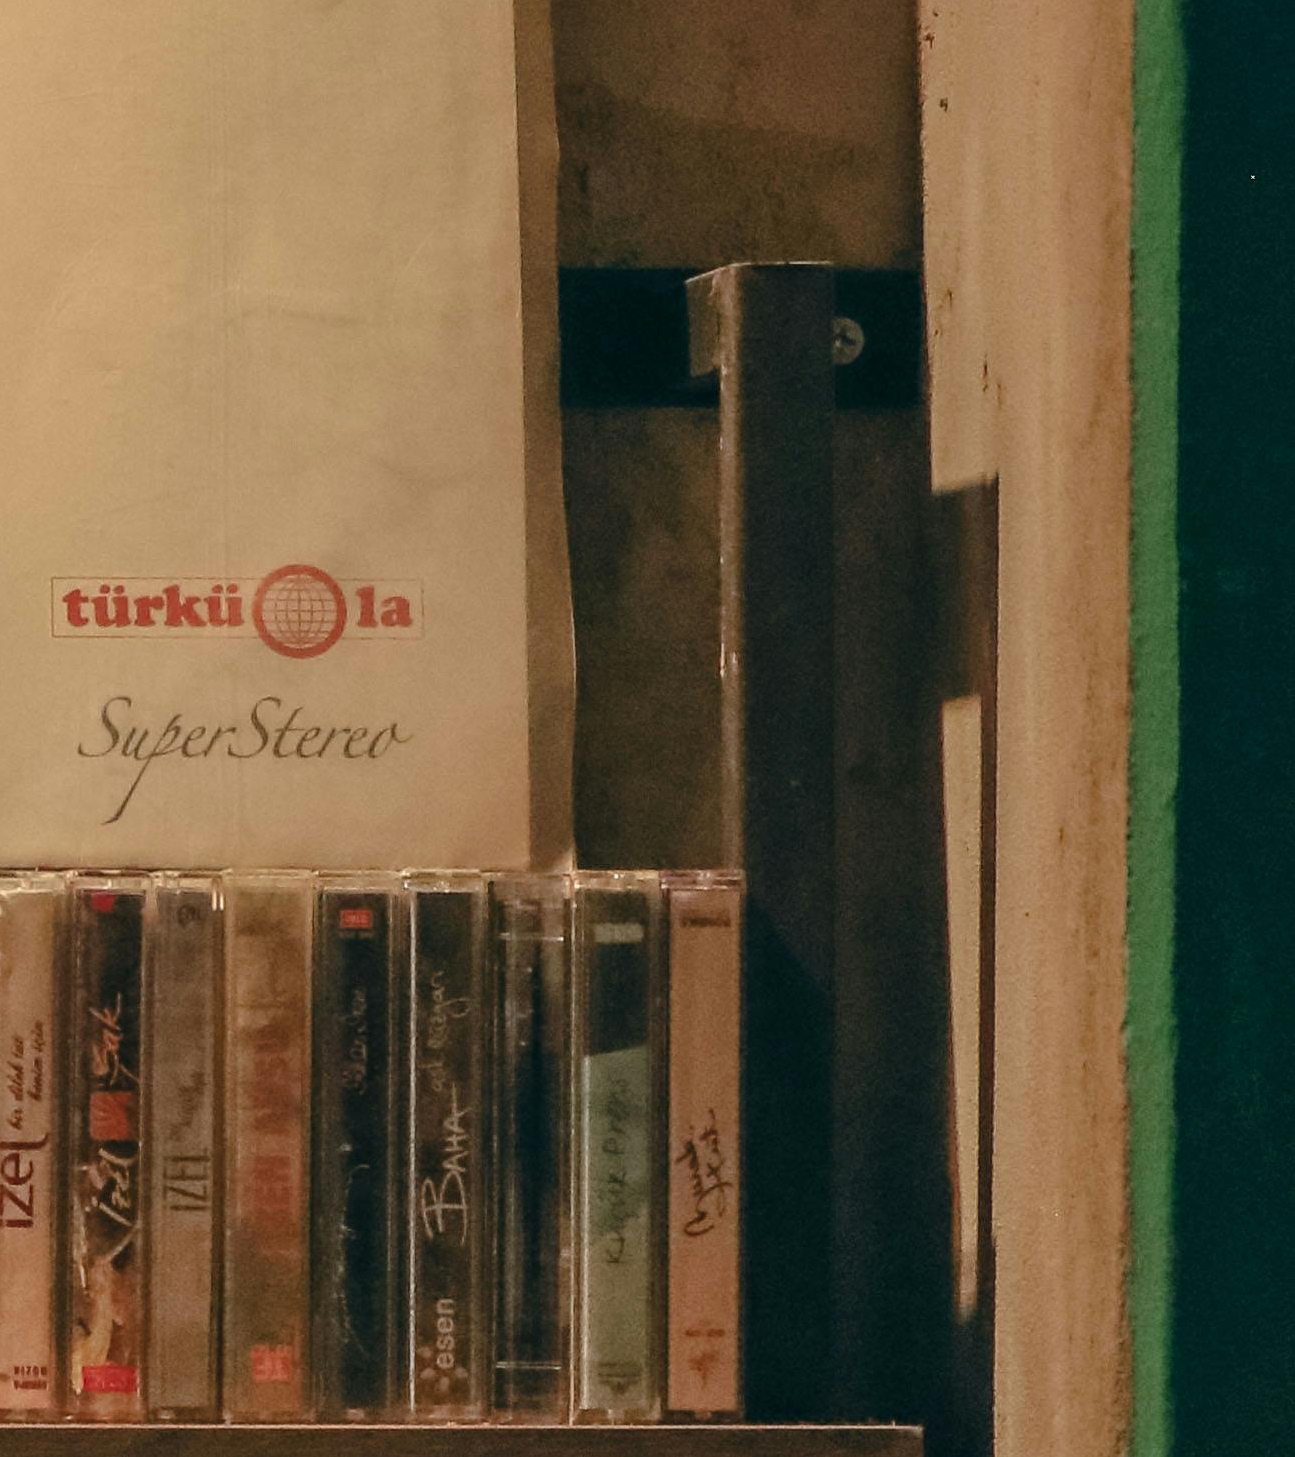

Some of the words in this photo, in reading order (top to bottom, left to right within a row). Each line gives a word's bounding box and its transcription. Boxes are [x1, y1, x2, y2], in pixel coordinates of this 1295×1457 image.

[61, 584, 243, 630] türkü
[420, 1083, 472, 1246] BAHA
[432, 1299, 456, 1370] esen
